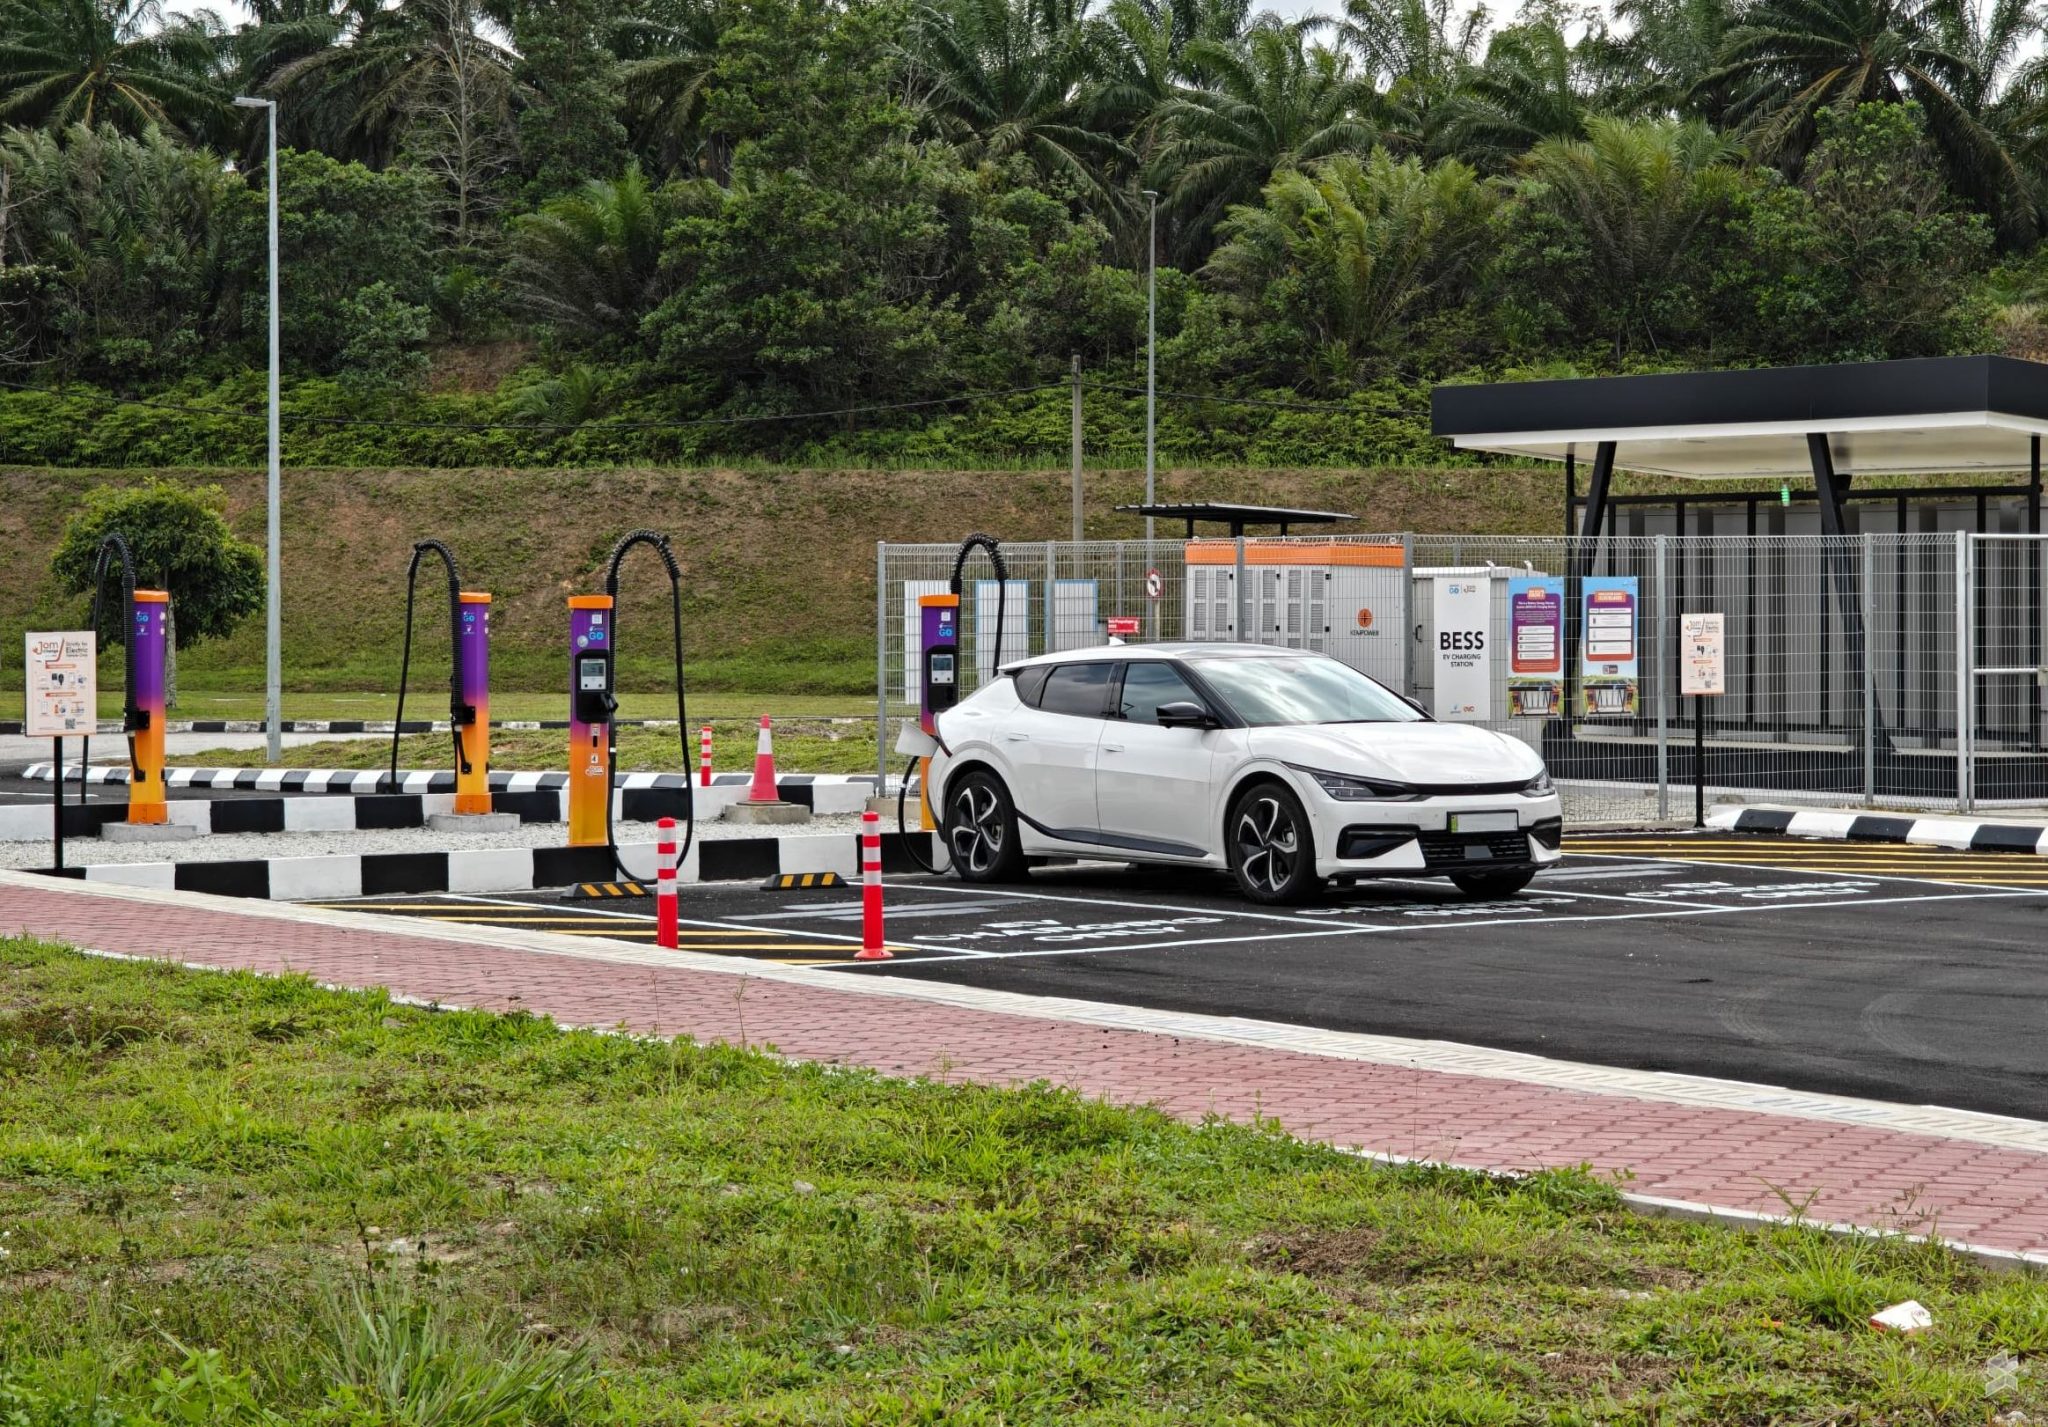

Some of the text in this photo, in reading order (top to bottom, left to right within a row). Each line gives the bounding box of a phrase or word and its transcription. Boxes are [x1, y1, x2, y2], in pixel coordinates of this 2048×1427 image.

[589, 632, 604, 640] GO
[939, 629, 953, 637] GO
[1440, 631, 1484, 650] BESS
[36, 641, 59, 655] Jom
